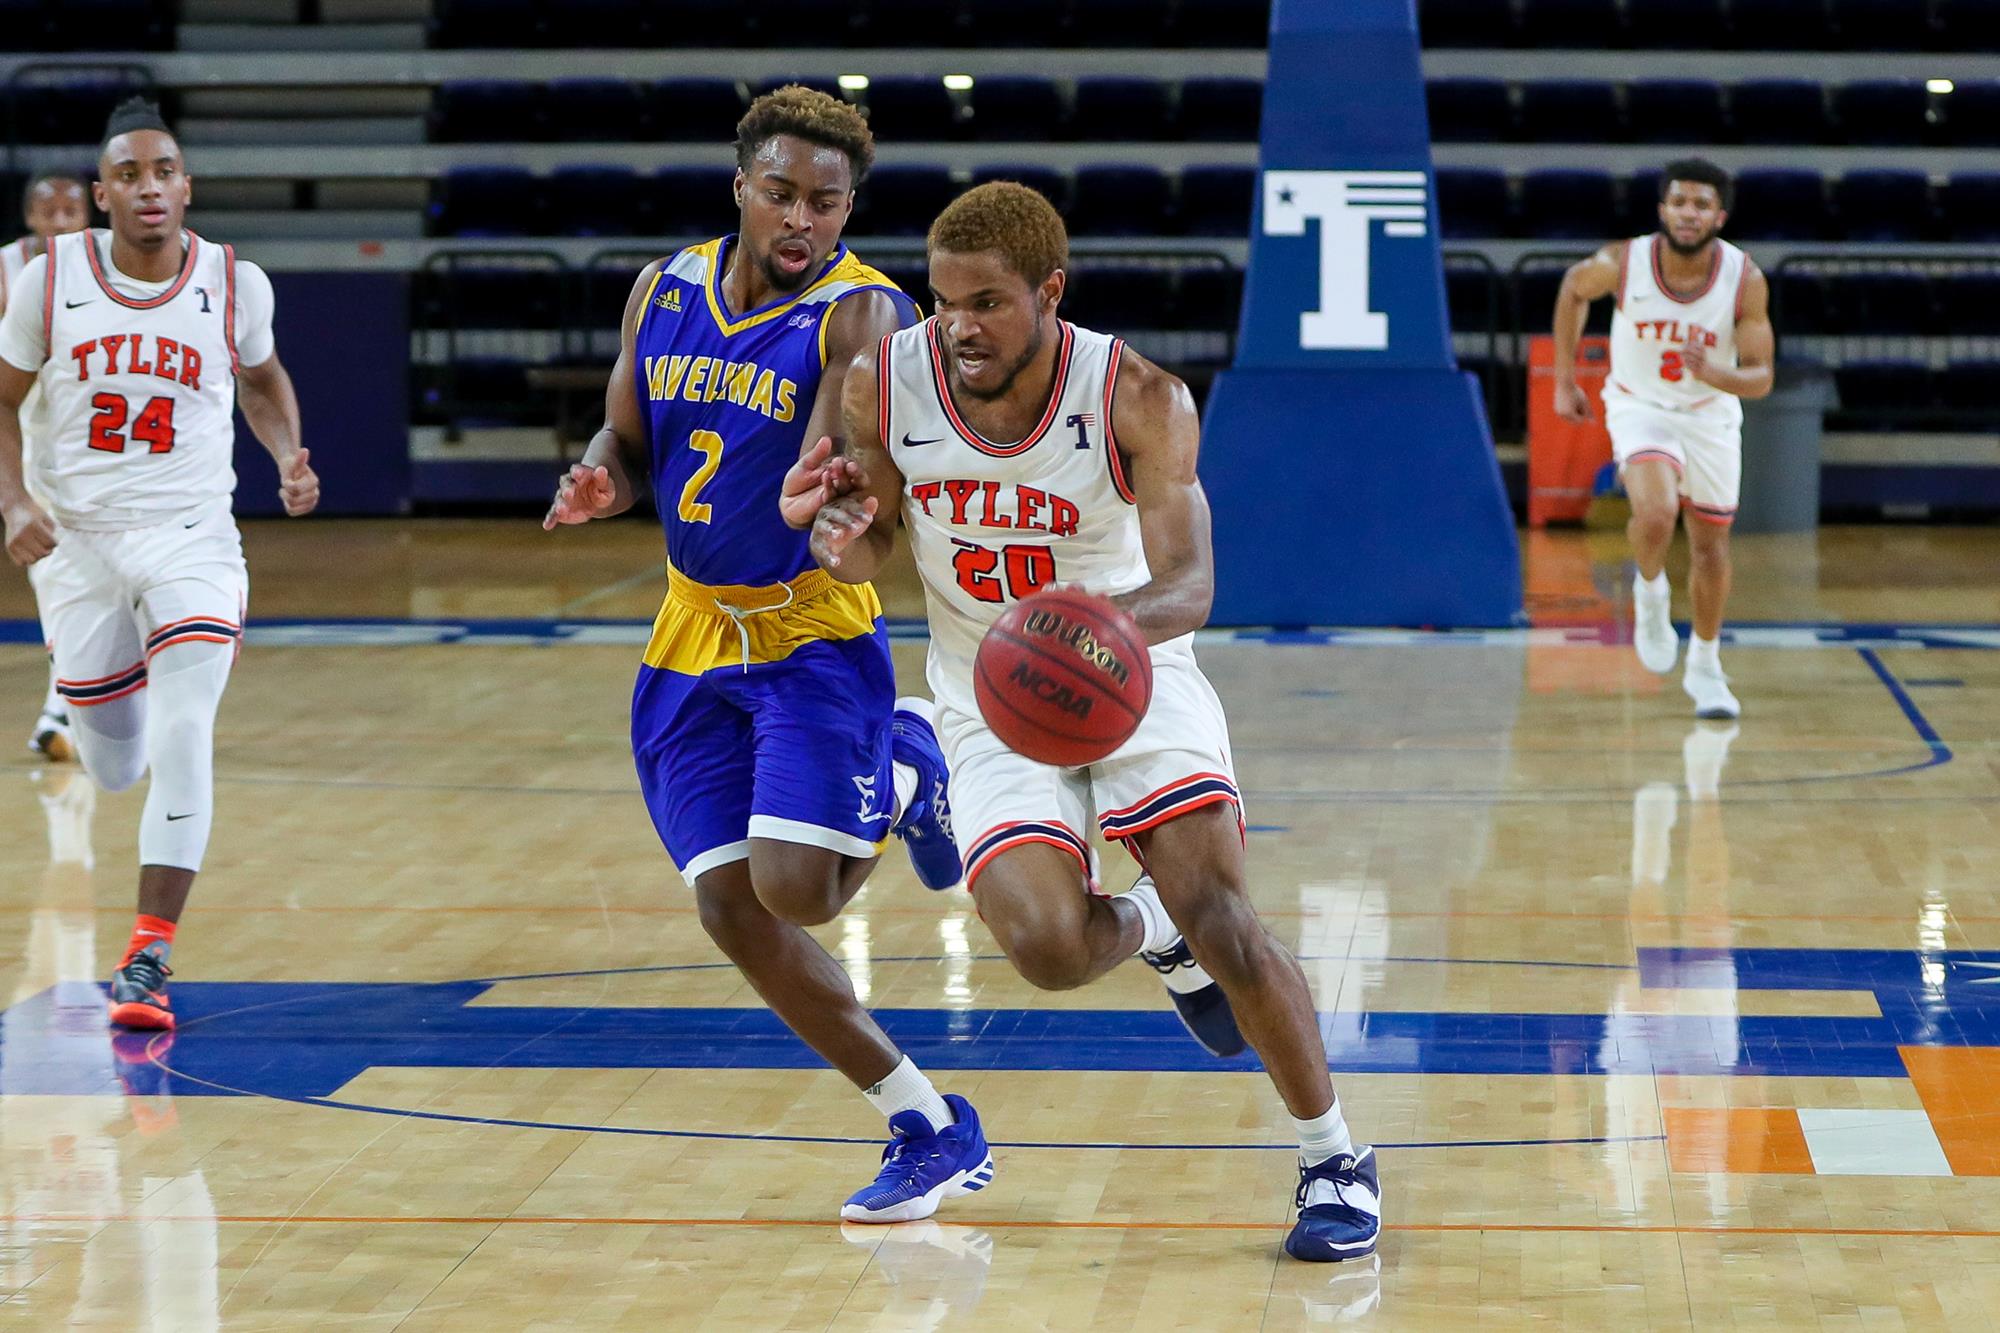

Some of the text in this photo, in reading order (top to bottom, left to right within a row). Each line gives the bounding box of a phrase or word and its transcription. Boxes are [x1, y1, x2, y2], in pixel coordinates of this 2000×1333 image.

[654, 297, 682, 313] adidas
[71, 333, 202, 391] TYLER
[88, 391, 176, 454] 24
[677, 429, 724, 525] 2
[911, 479, 1080, 537] TYLER
[950, 537, 1057, 603] 20
[1008, 660, 1095, 720] NCAA
